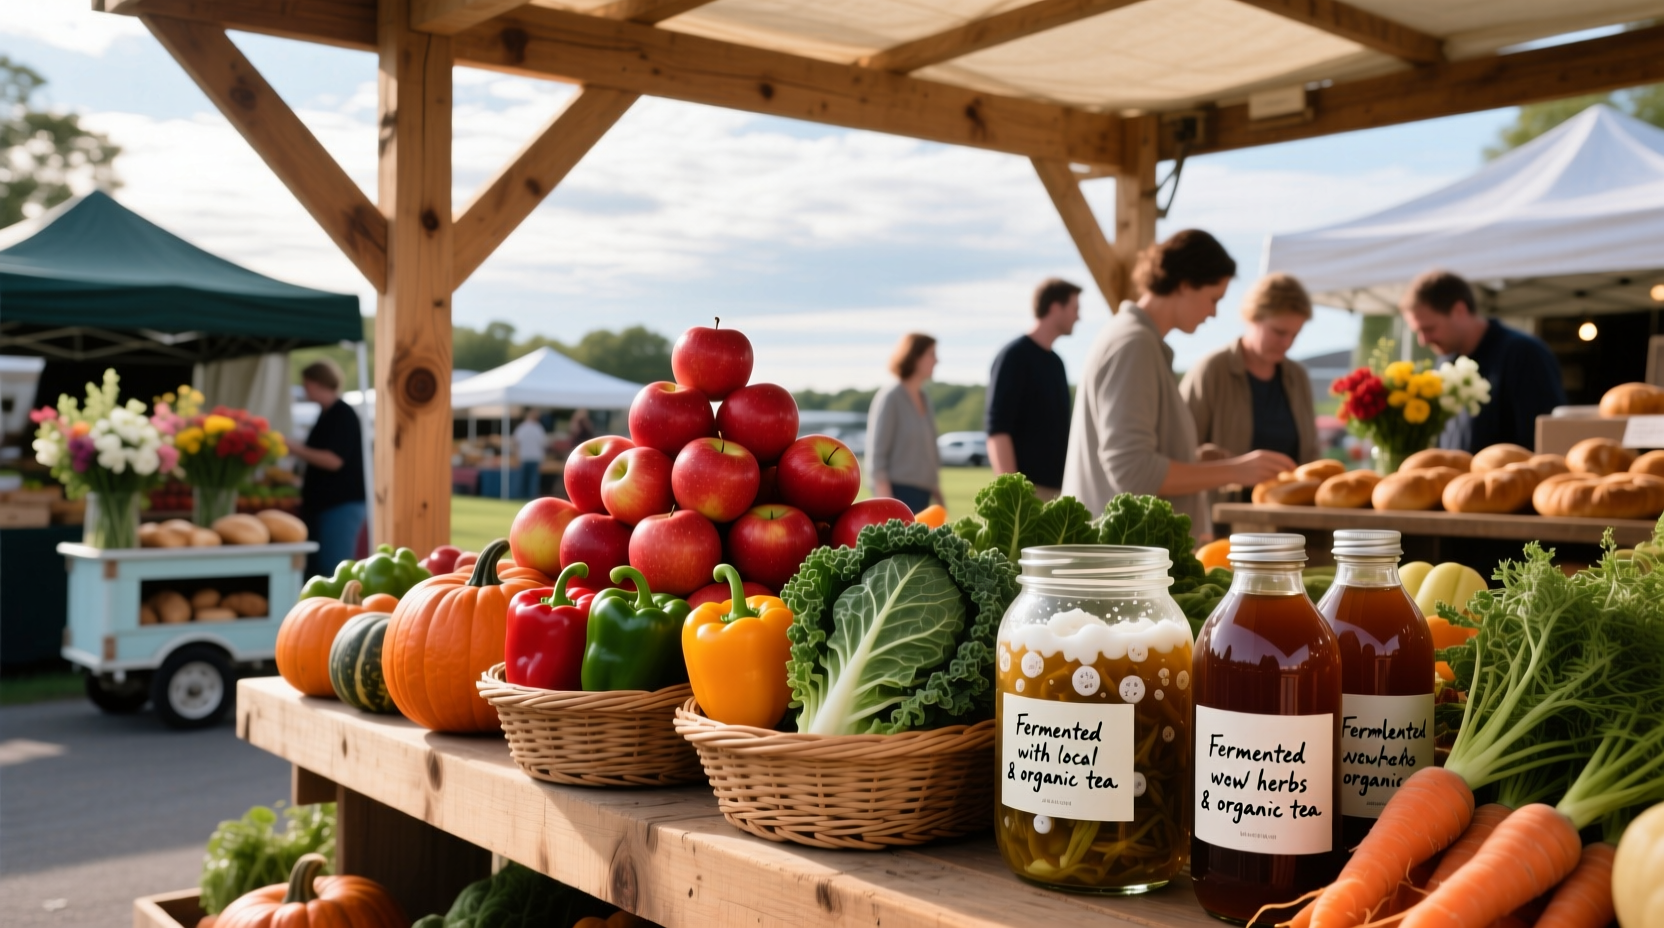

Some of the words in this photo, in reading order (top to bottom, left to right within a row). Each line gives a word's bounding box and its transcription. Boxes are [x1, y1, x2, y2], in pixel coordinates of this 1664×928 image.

[1016, 713, 1103, 742] Fermented
[1018, 741, 1050, 763] with
[1058, 744, 1099, 767] local
[1209, 733, 1306, 764] Fermented
[1007, 761, 1016, 781] &
[1020, 770, 1078, 793] organic
[1257, 768, 1307, 793] herbs
[1342, 772, 1403, 796] organic
[1201, 789, 1210, 811] &
[1217, 799, 1283, 824] organic
